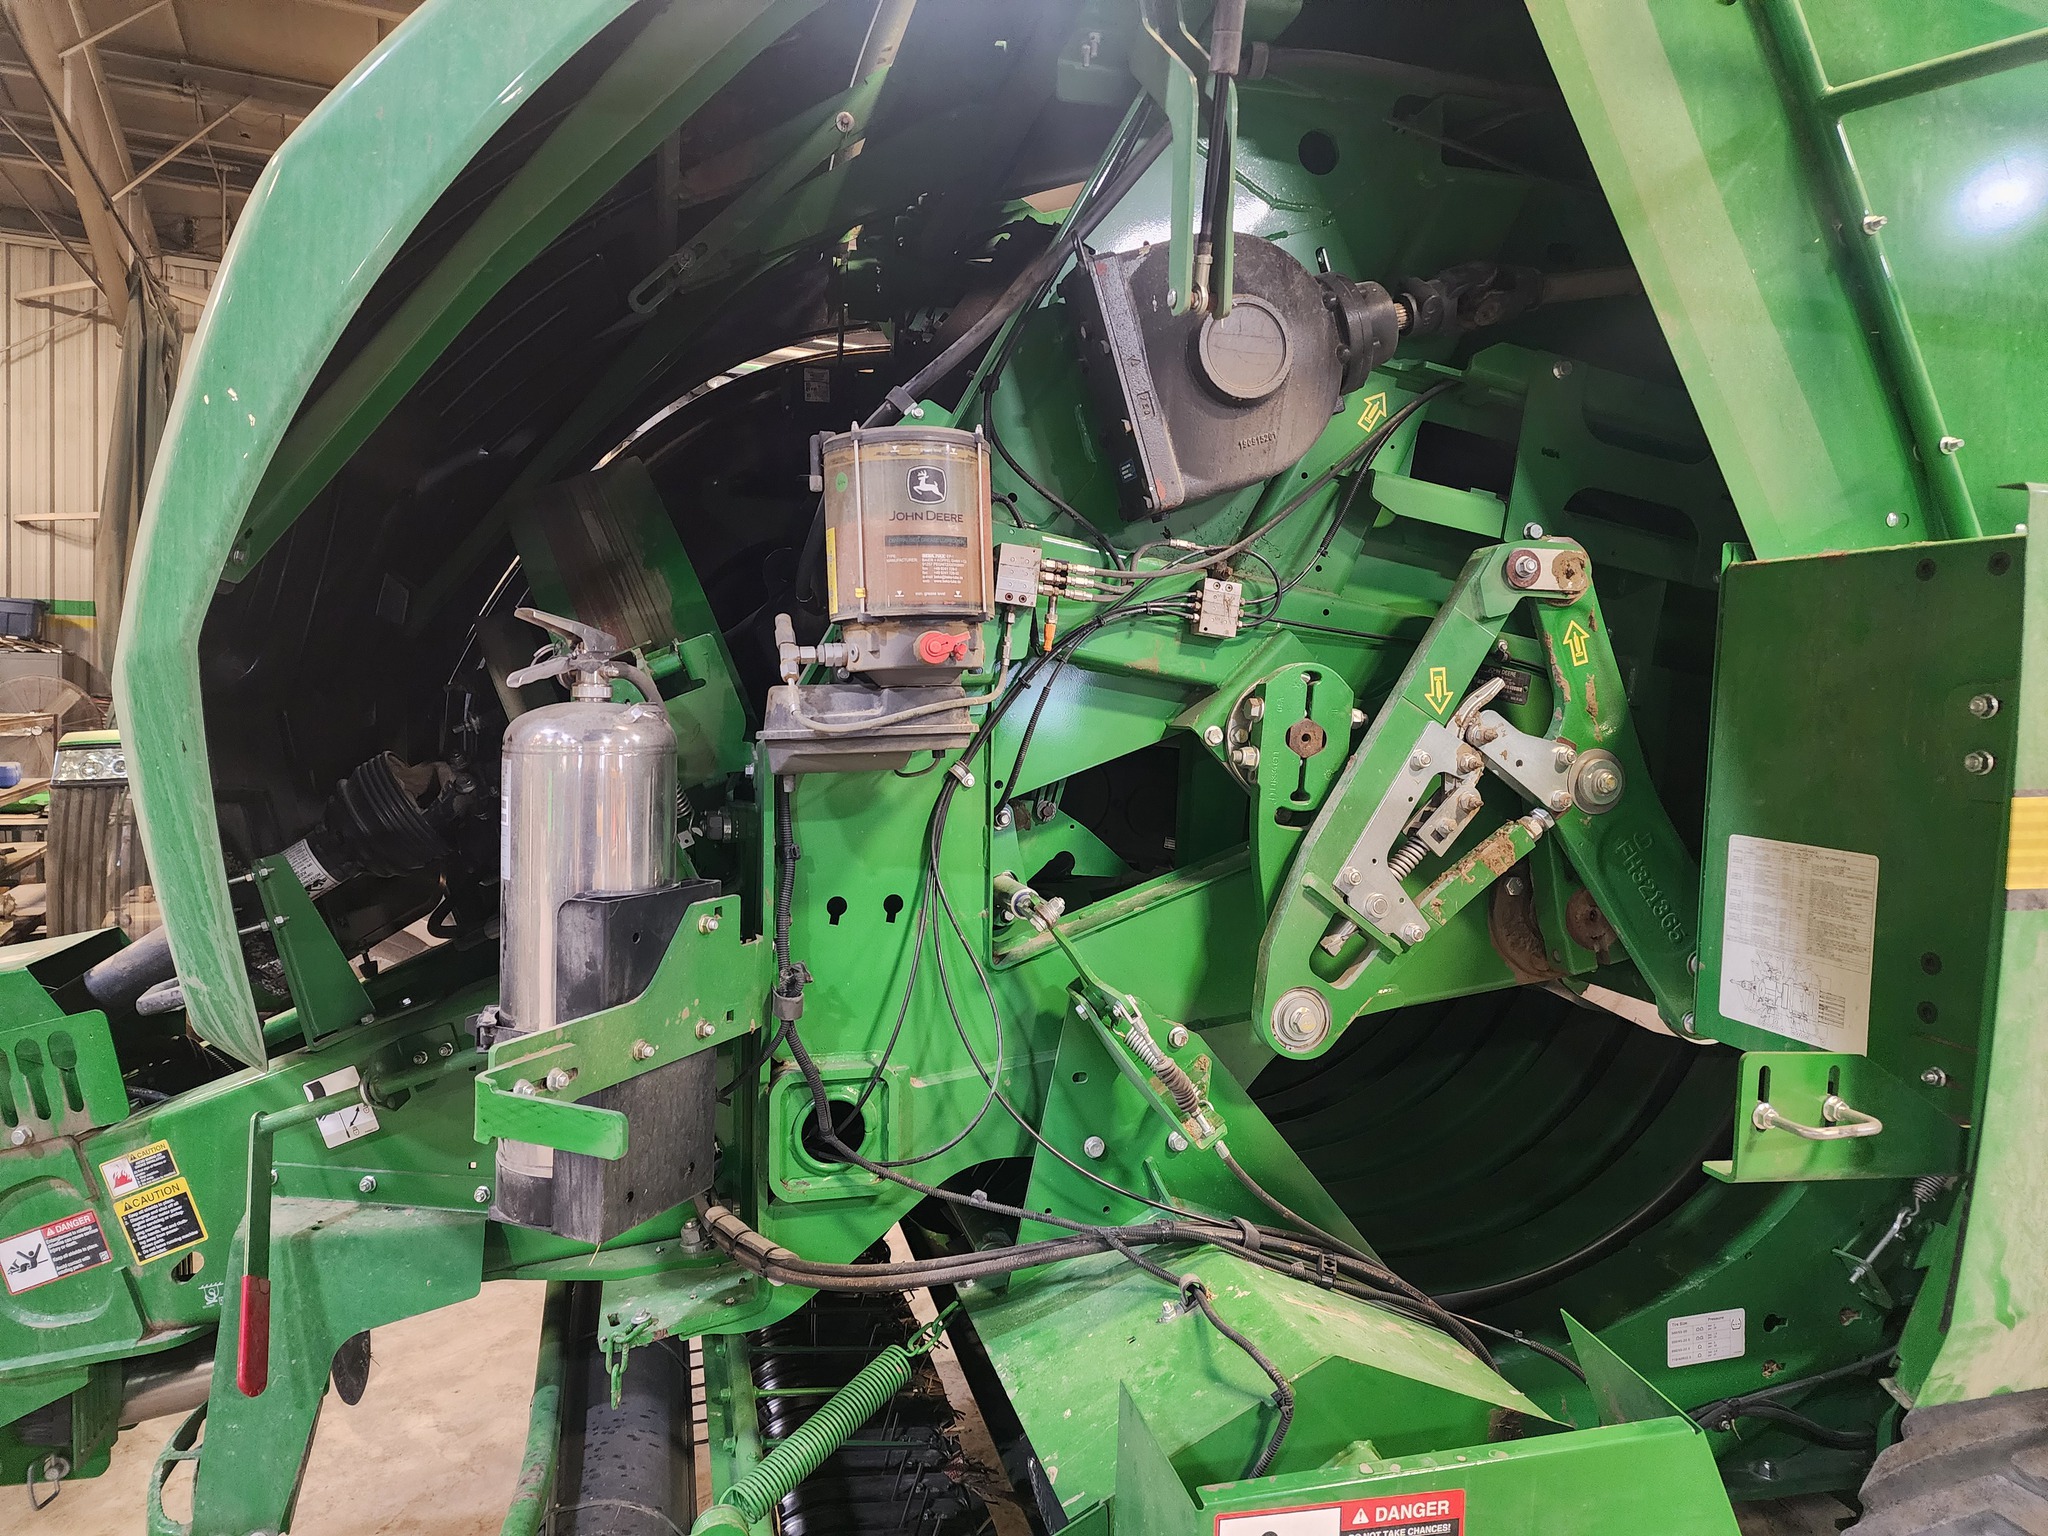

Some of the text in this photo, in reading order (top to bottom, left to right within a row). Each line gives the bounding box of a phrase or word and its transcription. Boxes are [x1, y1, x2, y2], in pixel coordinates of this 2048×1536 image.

[889, 510, 964, 522] JOHN DEERE
[136, 1144, 165, 1158] CAUTION
[132, 1183, 180, 1207] CAUTION
[55, 1215, 90, 1232] DANGER
[1375, 1500, 1450, 1522] DANGER
[1408, 1524, 1451, 1536] CHANCES!
